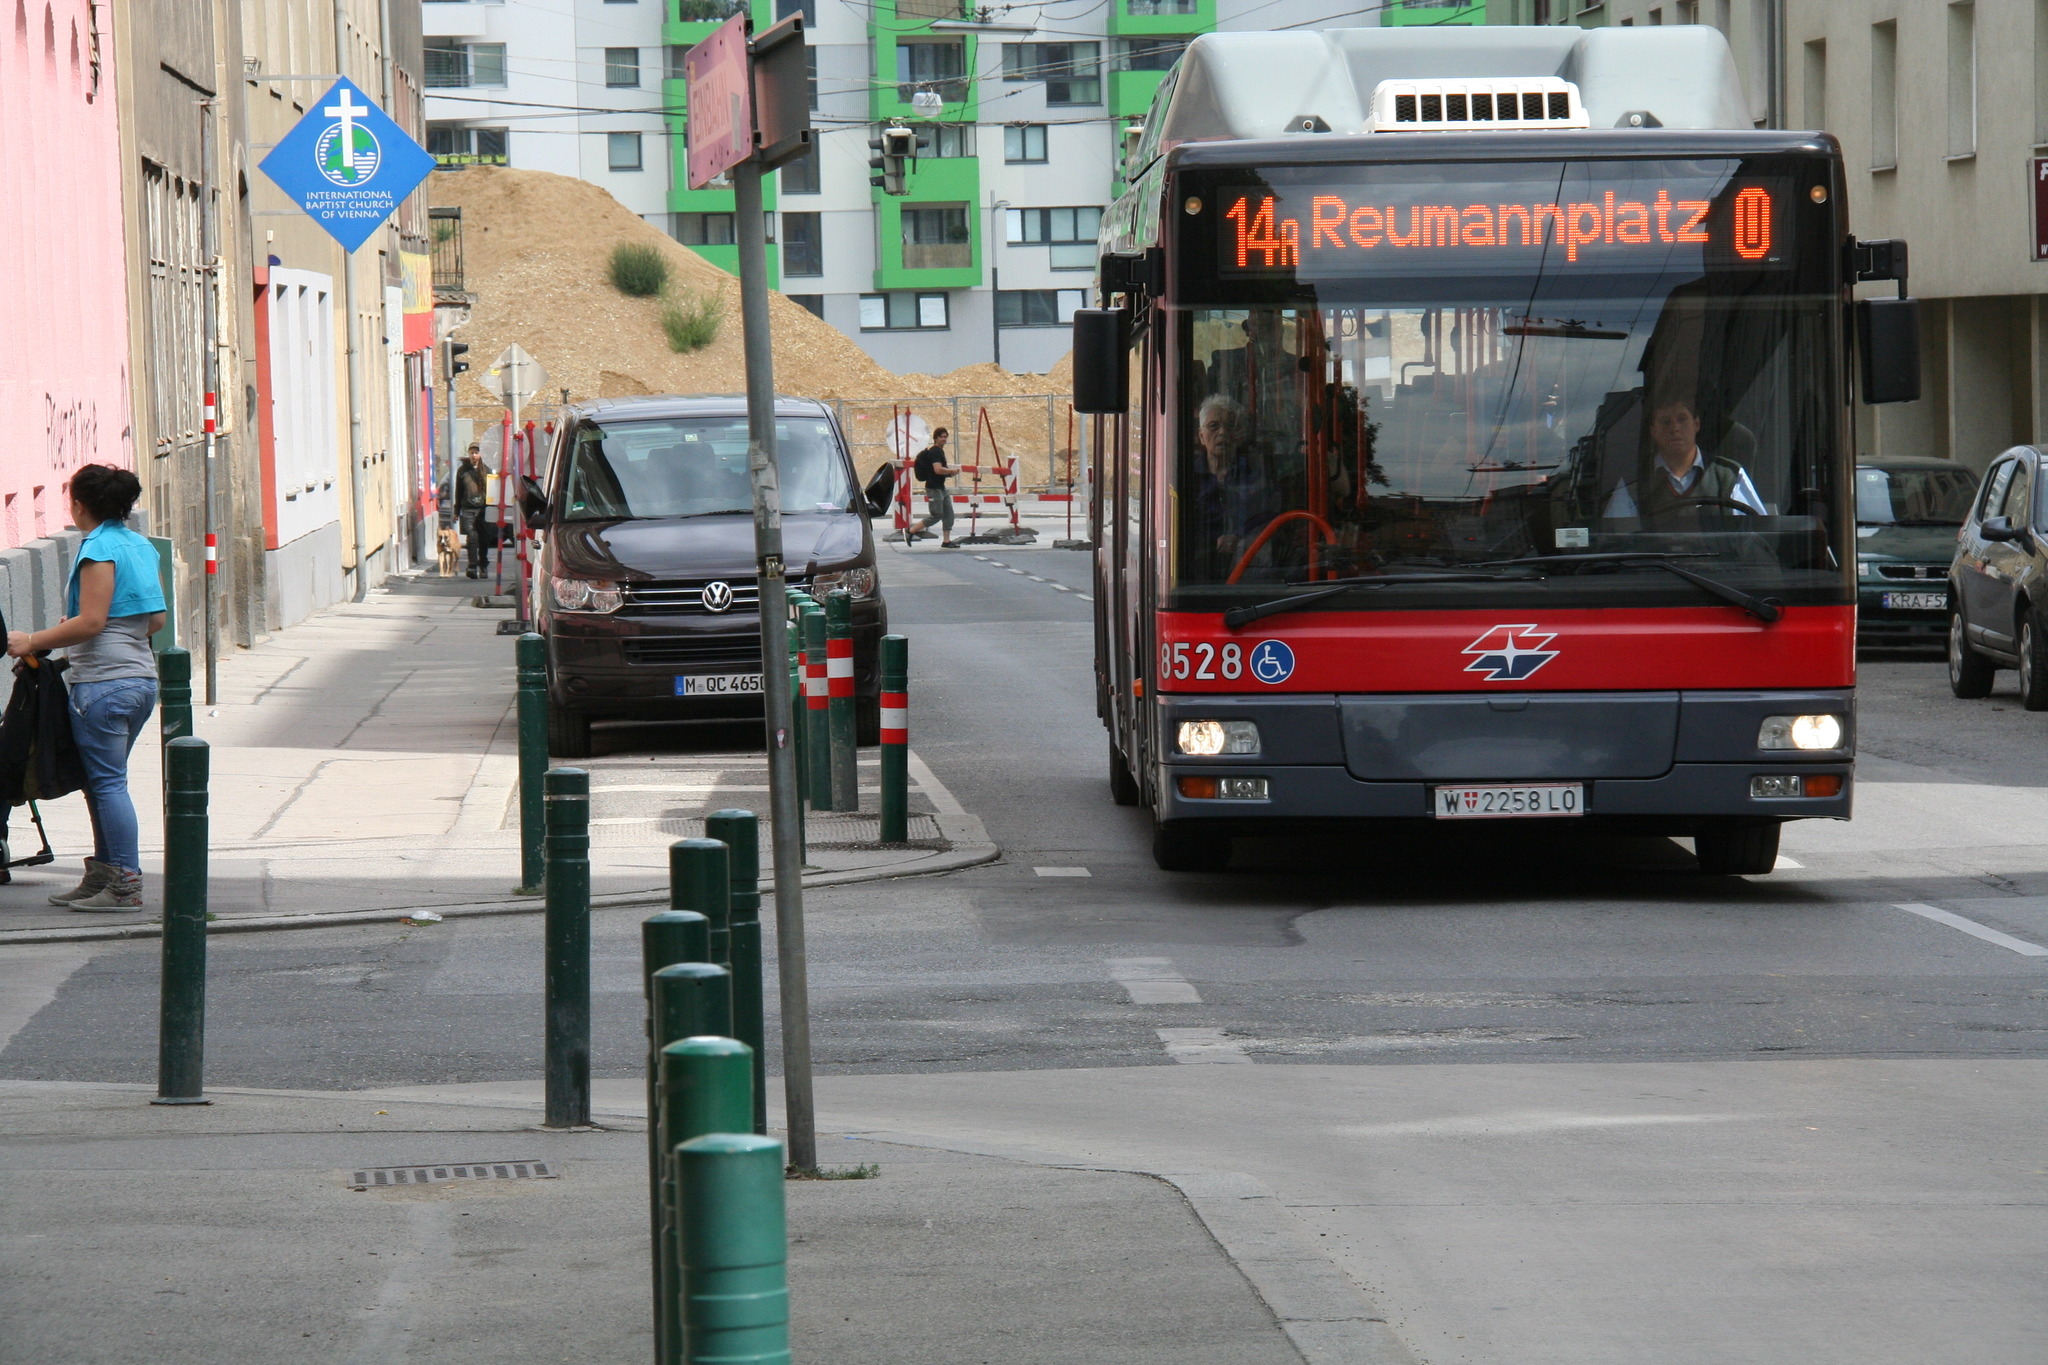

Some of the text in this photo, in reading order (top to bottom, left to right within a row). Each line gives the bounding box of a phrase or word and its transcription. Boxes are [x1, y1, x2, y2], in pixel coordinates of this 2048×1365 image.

[306, 190, 393, 200] INTERNATIONAL
[305, 200, 394, 210] BAPTIST CHURCH
[321, 210, 380, 219] OF VIENNA
[1226, 196, 1299, 267] 14A
[1313, 190, 1710, 262] Reumannplatz
[1890, 593, 1921, 609] KRA
[1161, 642, 1242, 680] 8528
[685, 678, 696, 693] M
[706, 677, 727, 692] QC
[1444, 792, 1460, 812] W
[1482, 791, 1541, 812] 2258
